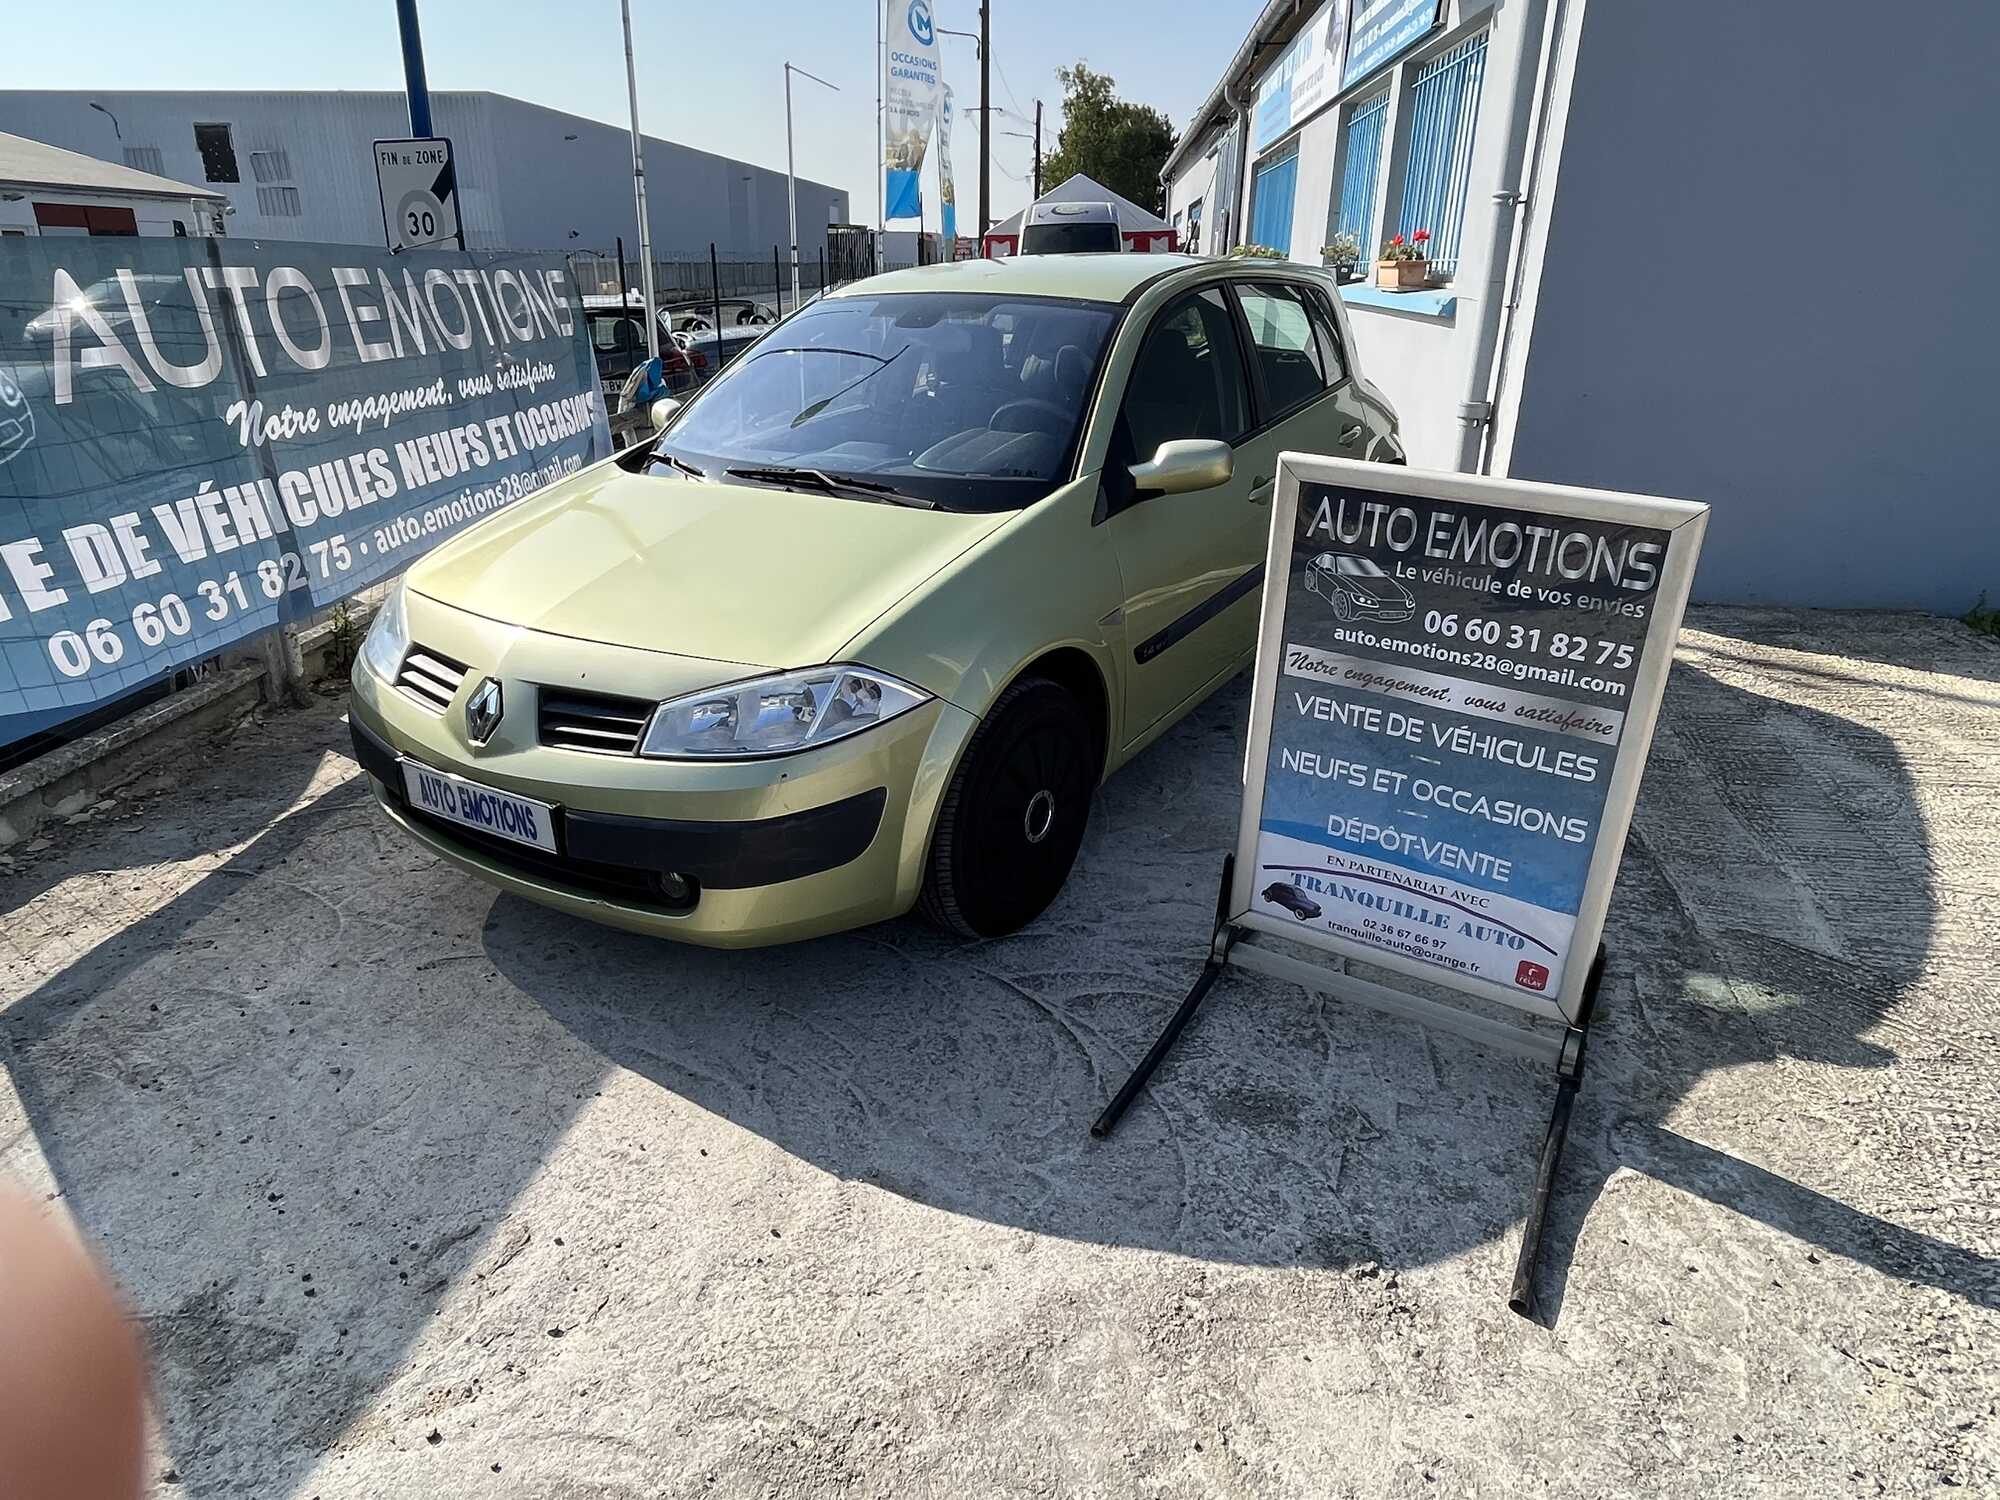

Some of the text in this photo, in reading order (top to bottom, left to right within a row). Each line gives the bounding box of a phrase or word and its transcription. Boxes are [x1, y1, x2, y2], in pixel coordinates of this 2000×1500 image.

[890, 66, 936, 85] GARANTIES
[891, 51, 937, 71] OCCASIONS
[381, 150, 444, 166] FIN DE ZONE
[408, 211, 435, 237] 30
[54, 267, 574, 405] AUTO EMOTIONS
[225, 358, 556, 447] Notre engagement, vous satisfaire
[61, 512, 162, 594] DE
[152, 448, 398, 564] VÉHICULES
[395, 423, 490, 490] NEUFS
[485, 415, 518, 461] ET
[1306, 496, 1662, 592] AUTO EMOTIONS
[48, 618, 124, 678] 06
[131, 593, 192, 647] 60
[197, 571, 249, 621] 31
[257, 552, 307, 599] 82
[309, 534, 352, 578] 75
[1396, 561, 1646, 619] Le véhicule de vos envies
[1334, 627, 1626, 697] auto.emotions28@gmail.com
[1424, 610, 1634, 670] 06 60 31 82 75
[1289, 650, 1614, 736] Notre engagement, vous satisfaire
[1294, 692, 1599, 783] VENTE DE VÉHICULES
[419, 773, 538, 841] AUTO EMOTIONS
[1281, 747, 1589, 844] NEUFS ET OCCASIONS
[1326, 815, 1512, 883] DÉPÔT-VENTE
[1326, 855, 1490, 909] EN PARTENARIAT AVEC
[1291, 872, 1526, 952] TRANQUILLE AUTO
[1363, 918, 1448, 950] 02 36 67 66 97
